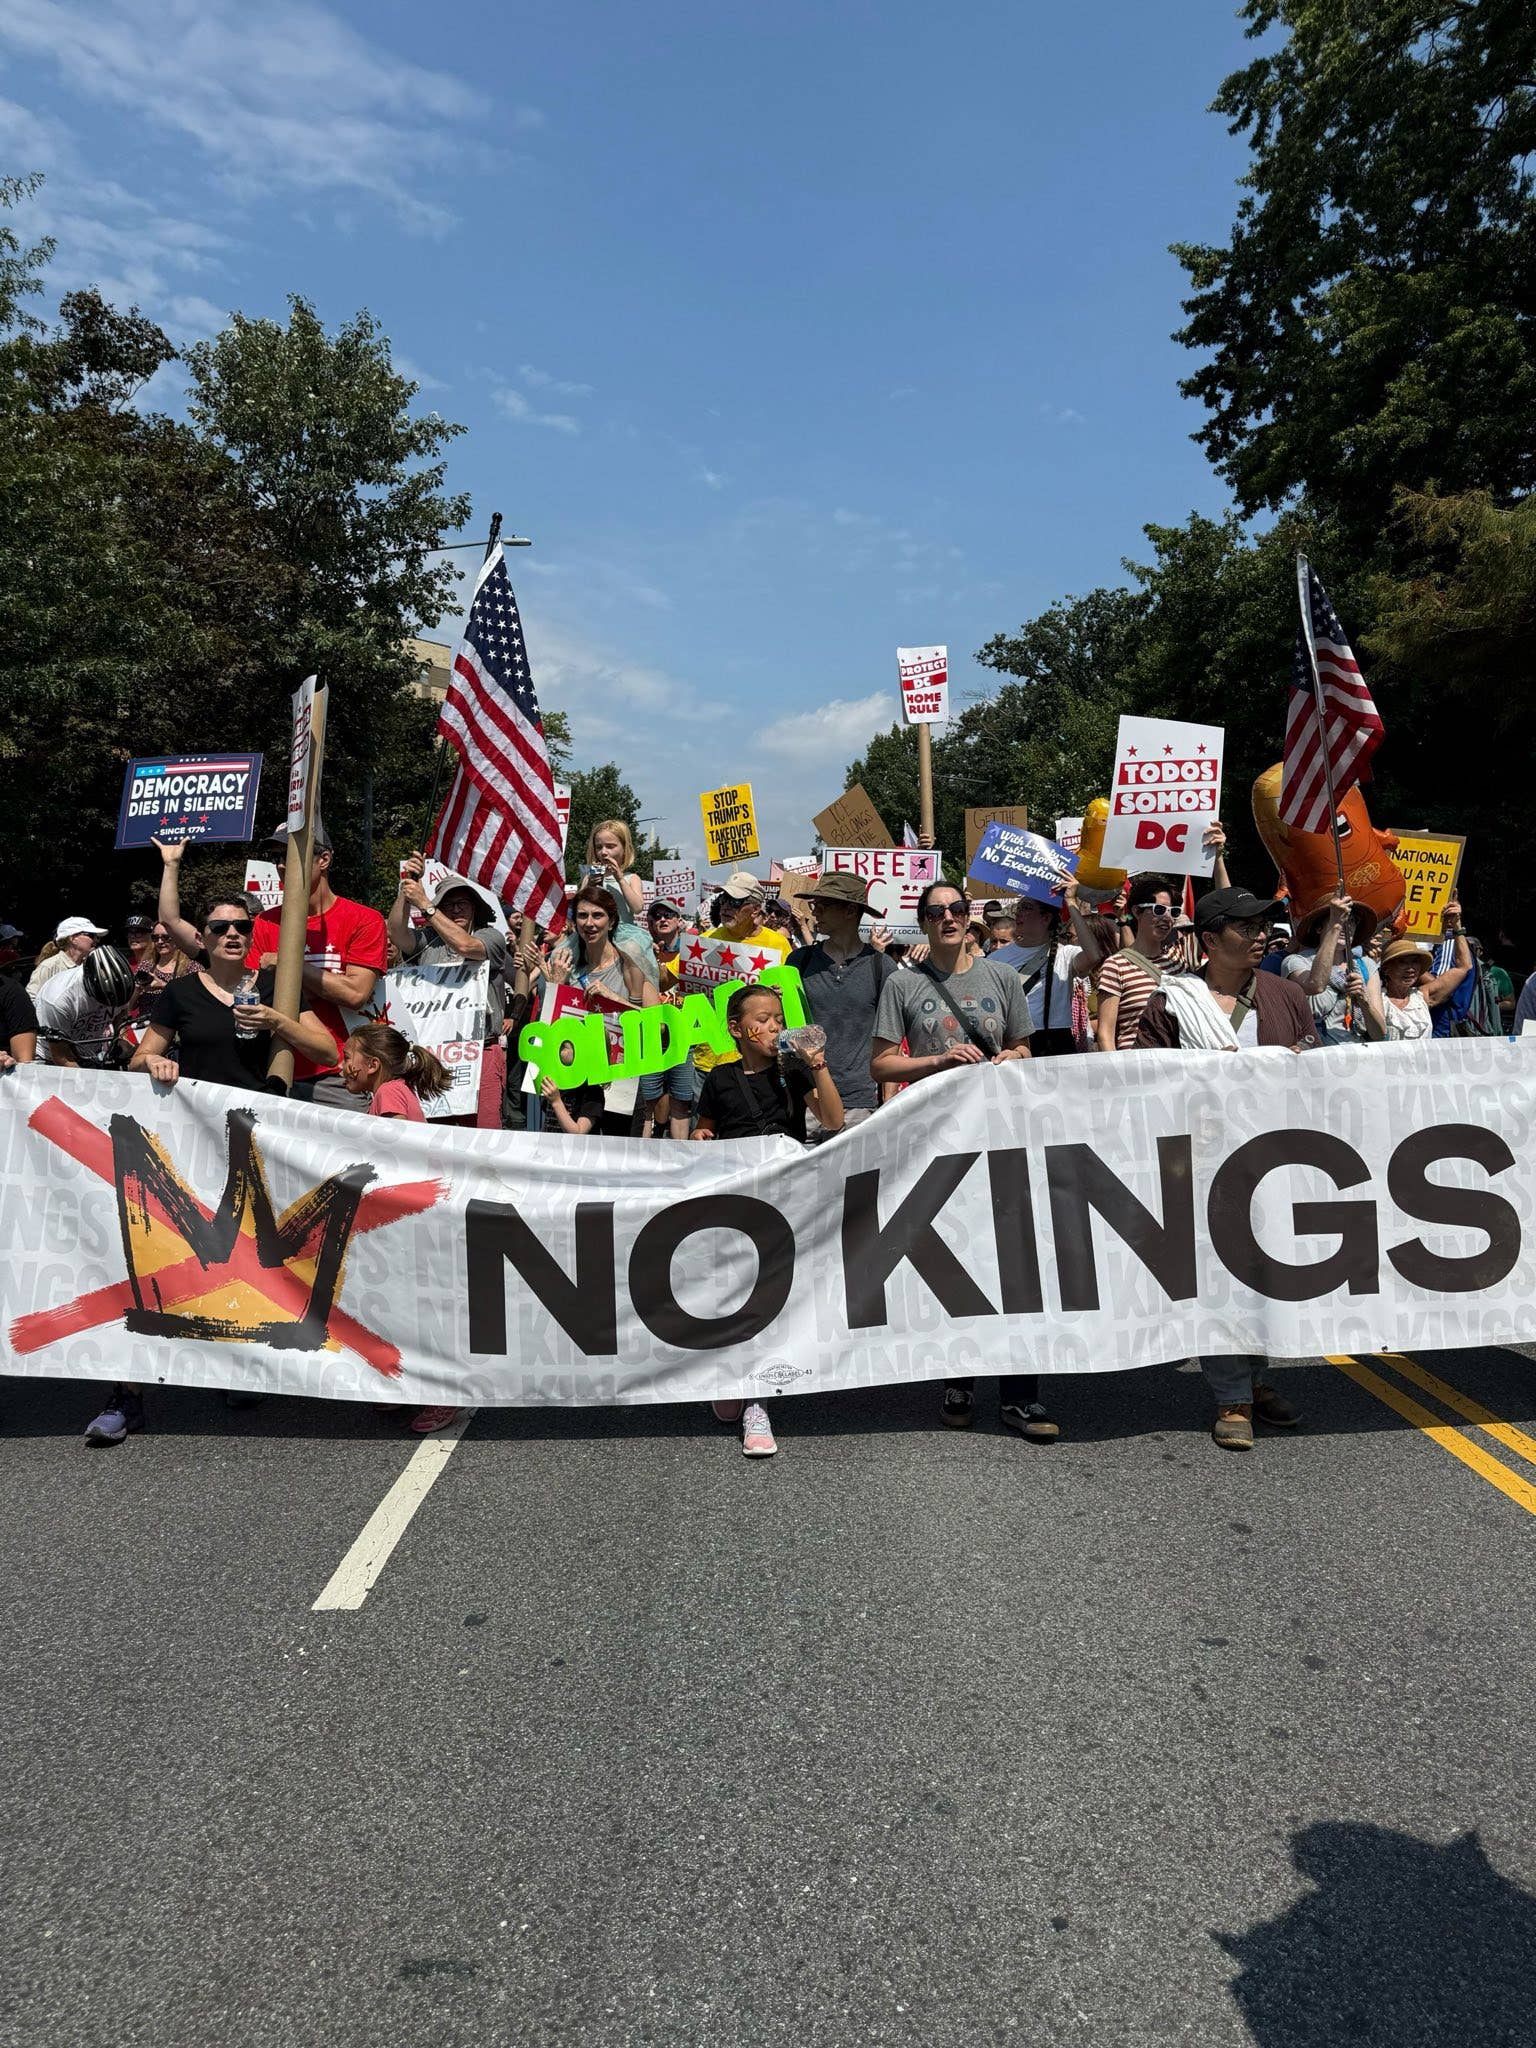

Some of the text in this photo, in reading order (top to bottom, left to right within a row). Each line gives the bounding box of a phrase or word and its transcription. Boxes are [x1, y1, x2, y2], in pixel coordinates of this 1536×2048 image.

[901, 659, 945, 676] PROTECT
[914, 677, 931, 689] DC
[906, 692, 942, 704] HOME
[909, 704, 940, 715] RULE
[1124, 761, 1213, 784] TODOS
[131, 773, 249, 800] DEMOCRACY
[128, 796, 244, 817] DIES IN SILENCE
[714, 789, 738, 810] STOP
[1121, 790, 1212, 815] SOMOS
[707, 804, 750, 827] TRUMP'S
[829, 799, 857, 825] ICE
[160, 826, 206, 836] SINCE 1776
[709, 823, 753, 844] TAKEOVER
[1000, 830, 1026, 847] With
[1135, 820, 1188, 853] DC
[718, 839, 749, 858] OF DC!
[981, 846, 1000, 863] No
[995, 840, 1032, 860] Justice
[1391, 849, 1453, 866] NATIONAL
[834, 851, 905, 878] FREE
[658, 872, 693, 885] TODOS
[1404, 868, 1449, 884] UARD
[260, 881, 279, 892] WE
[658, 882, 693, 896] SOMOS
[1409, 885, 1442, 904] ET
[1405, 910, 1439, 928] UT
[685, 962, 760, 986] STATEHOO
[466, 1194, 795, 1357] NO
[842, 1123, 1522, 1330] KINGS
